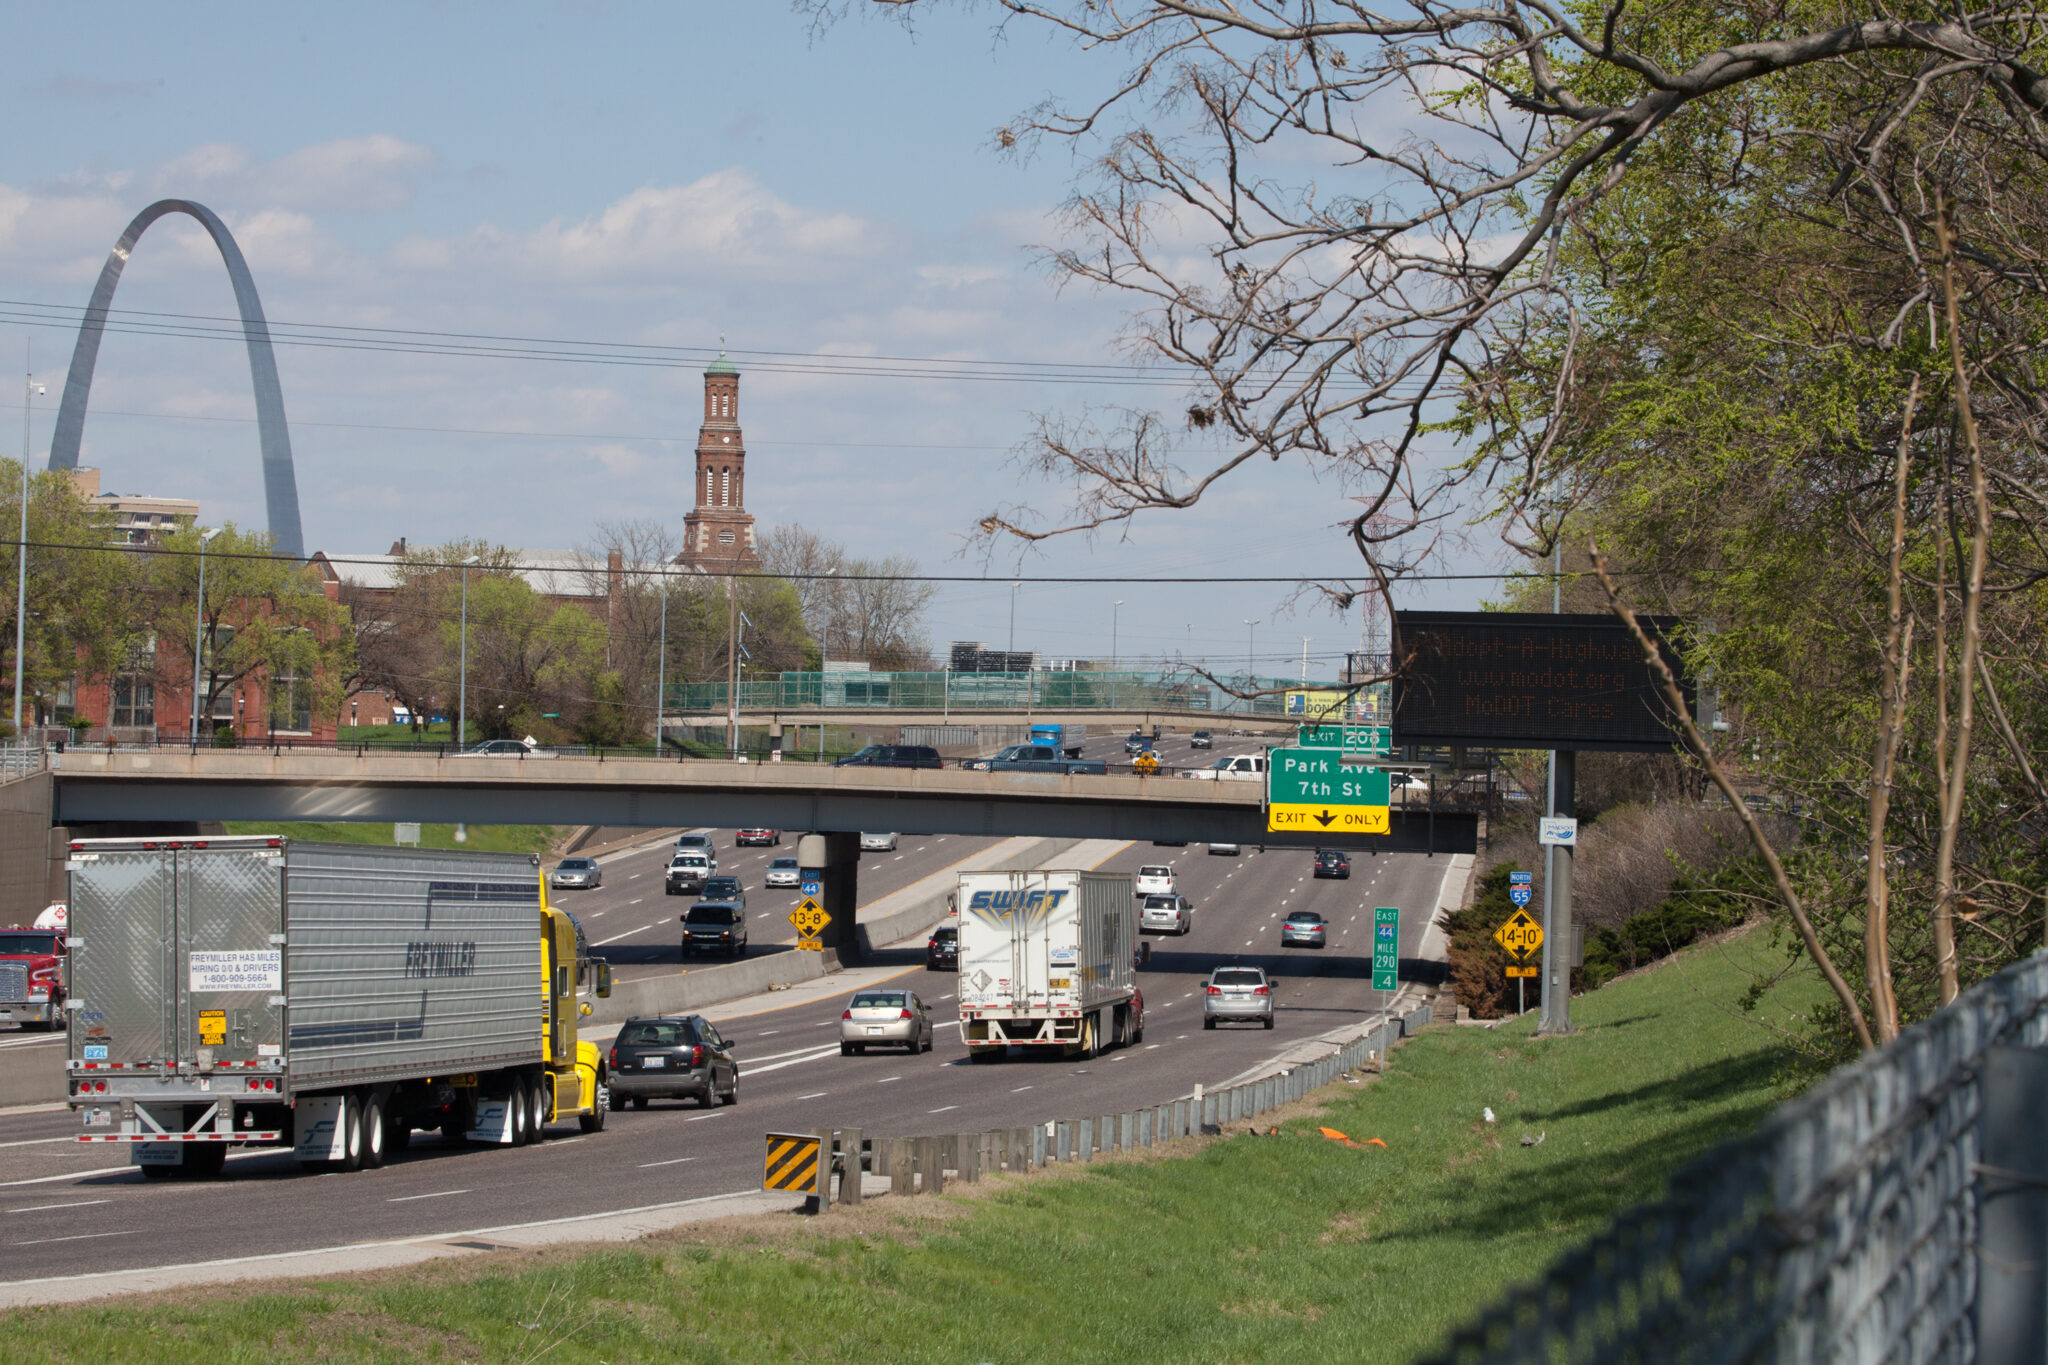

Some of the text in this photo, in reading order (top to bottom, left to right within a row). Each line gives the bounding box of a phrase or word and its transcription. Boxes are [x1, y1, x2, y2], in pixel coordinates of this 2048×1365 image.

[1458, 666, 1625, 692] www.modot.org
[1465, 694, 1614, 719] MoDOT Cares
[1309, 732, 1335, 742] EXIT
[1285, 758, 1376, 774] Park Ave
[1298, 781, 1362, 796] 7th St
[1276, 812, 1382, 825] EXIT ONLY
[804, 885, 816, 893] 44
[969, 889, 1069, 909] SWIFT
[1513, 891, 1529, 903] 55
[1376, 910, 1397, 921] EAST
[1379, 927, 1393, 937] 44
[1377, 943, 1394, 953] MILE
[190, 952, 280, 963] FREYMILLER HAS MILES
[405, 941, 476, 978] FREYMILLER
[1376, 955, 1395, 968] 290
[191, 964, 219, 973] HIRING
[235, 964, 240, 972] &
[243, 963, 279, 972] DRIVERS
[203, 973, 268, 983] 1-800-909-5664
